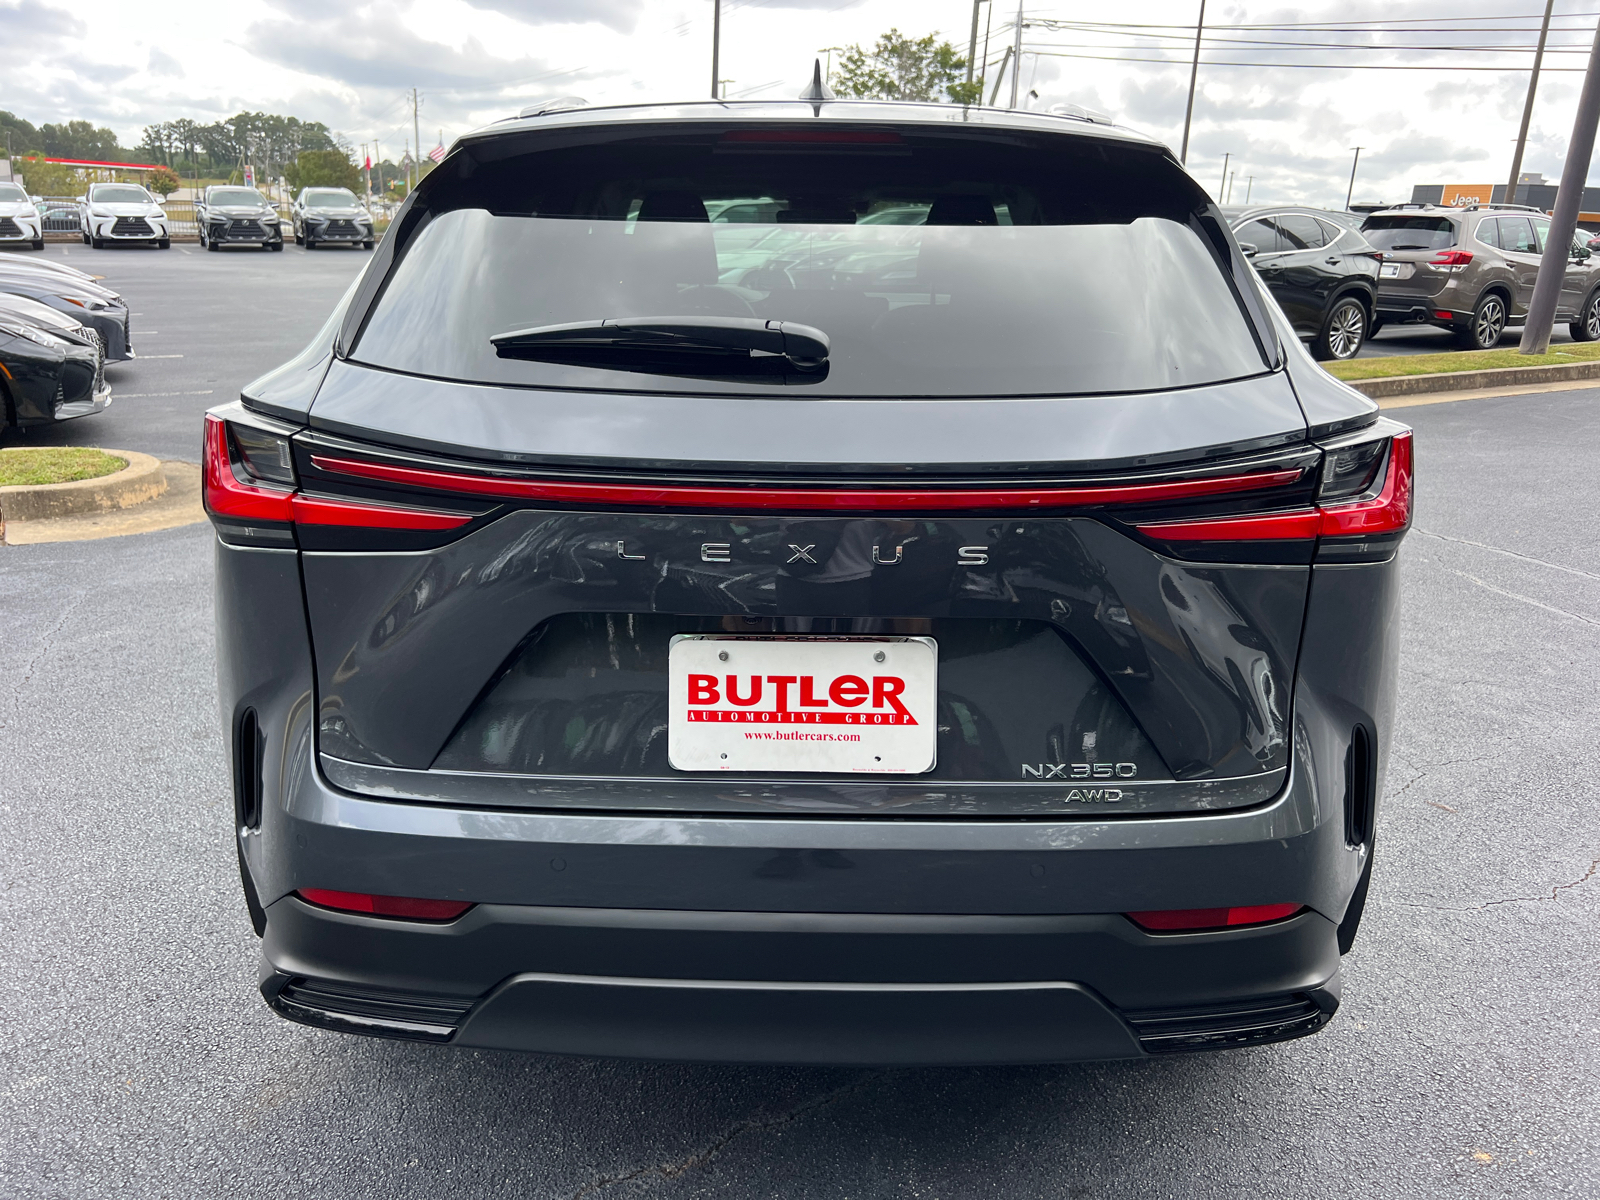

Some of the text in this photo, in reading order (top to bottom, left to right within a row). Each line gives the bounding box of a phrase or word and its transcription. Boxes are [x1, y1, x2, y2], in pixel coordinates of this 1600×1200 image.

[617, 540, 989, 566] LEXUS
[689, 711, 910, 724] AUTOMOTIVE GROUP
[744, 730, 861, 742] www.butlercars.com
[1064, 789, 1123, 803] AWD
